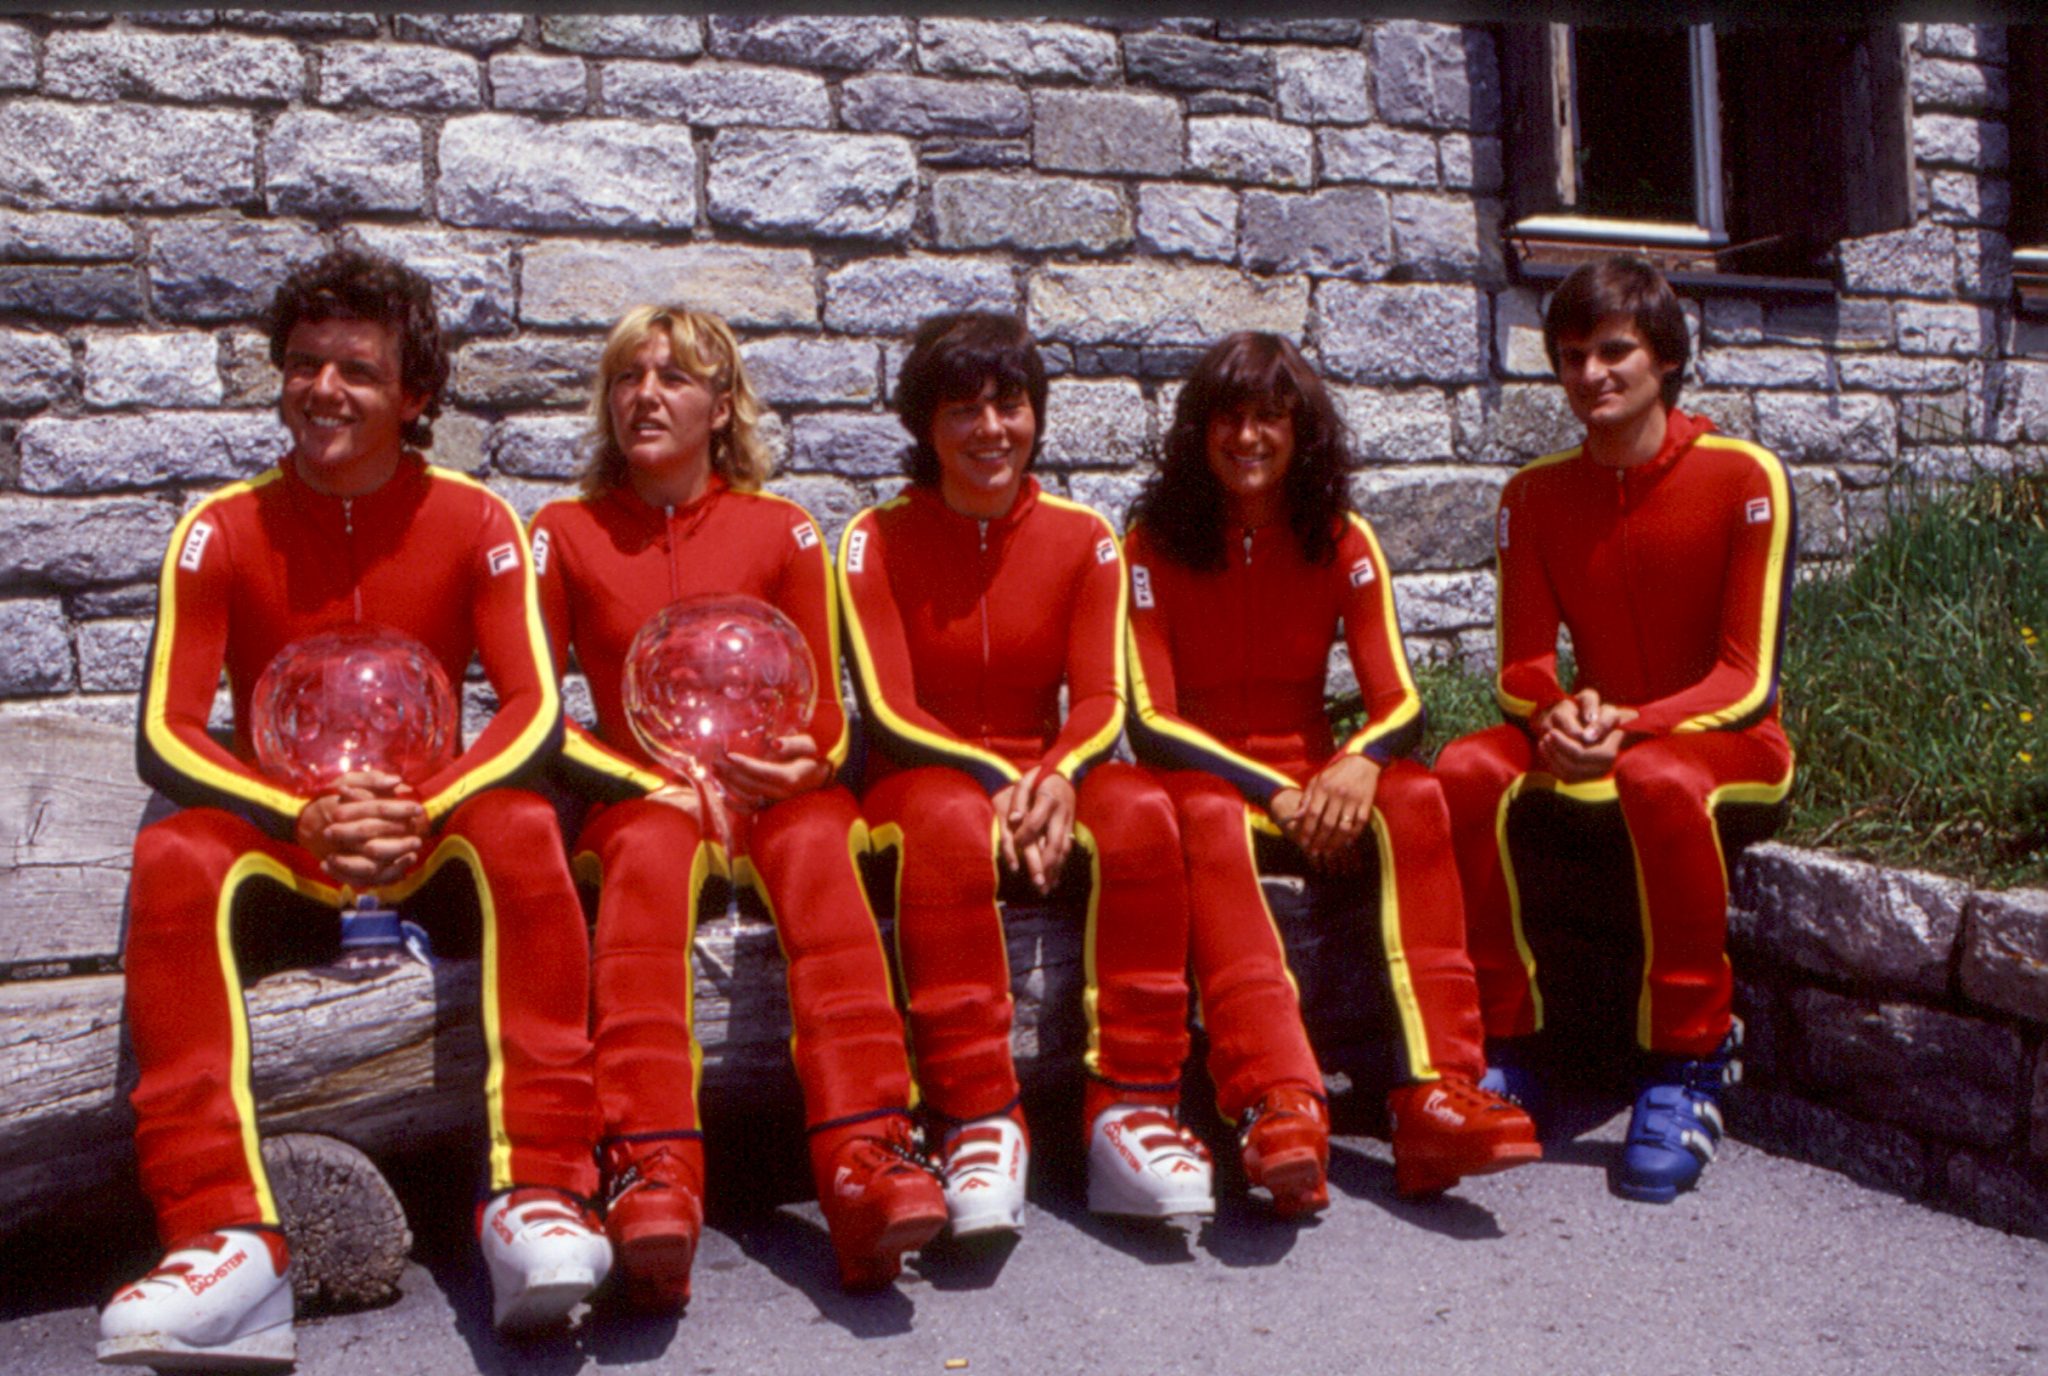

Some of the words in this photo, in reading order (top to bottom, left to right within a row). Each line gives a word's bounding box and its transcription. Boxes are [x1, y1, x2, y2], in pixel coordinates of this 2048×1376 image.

[185, 529, 205, 562] FILA
[850, 536, 861, 566] FILA
[191, 1249, 248, 1296] DACHSTEIN
